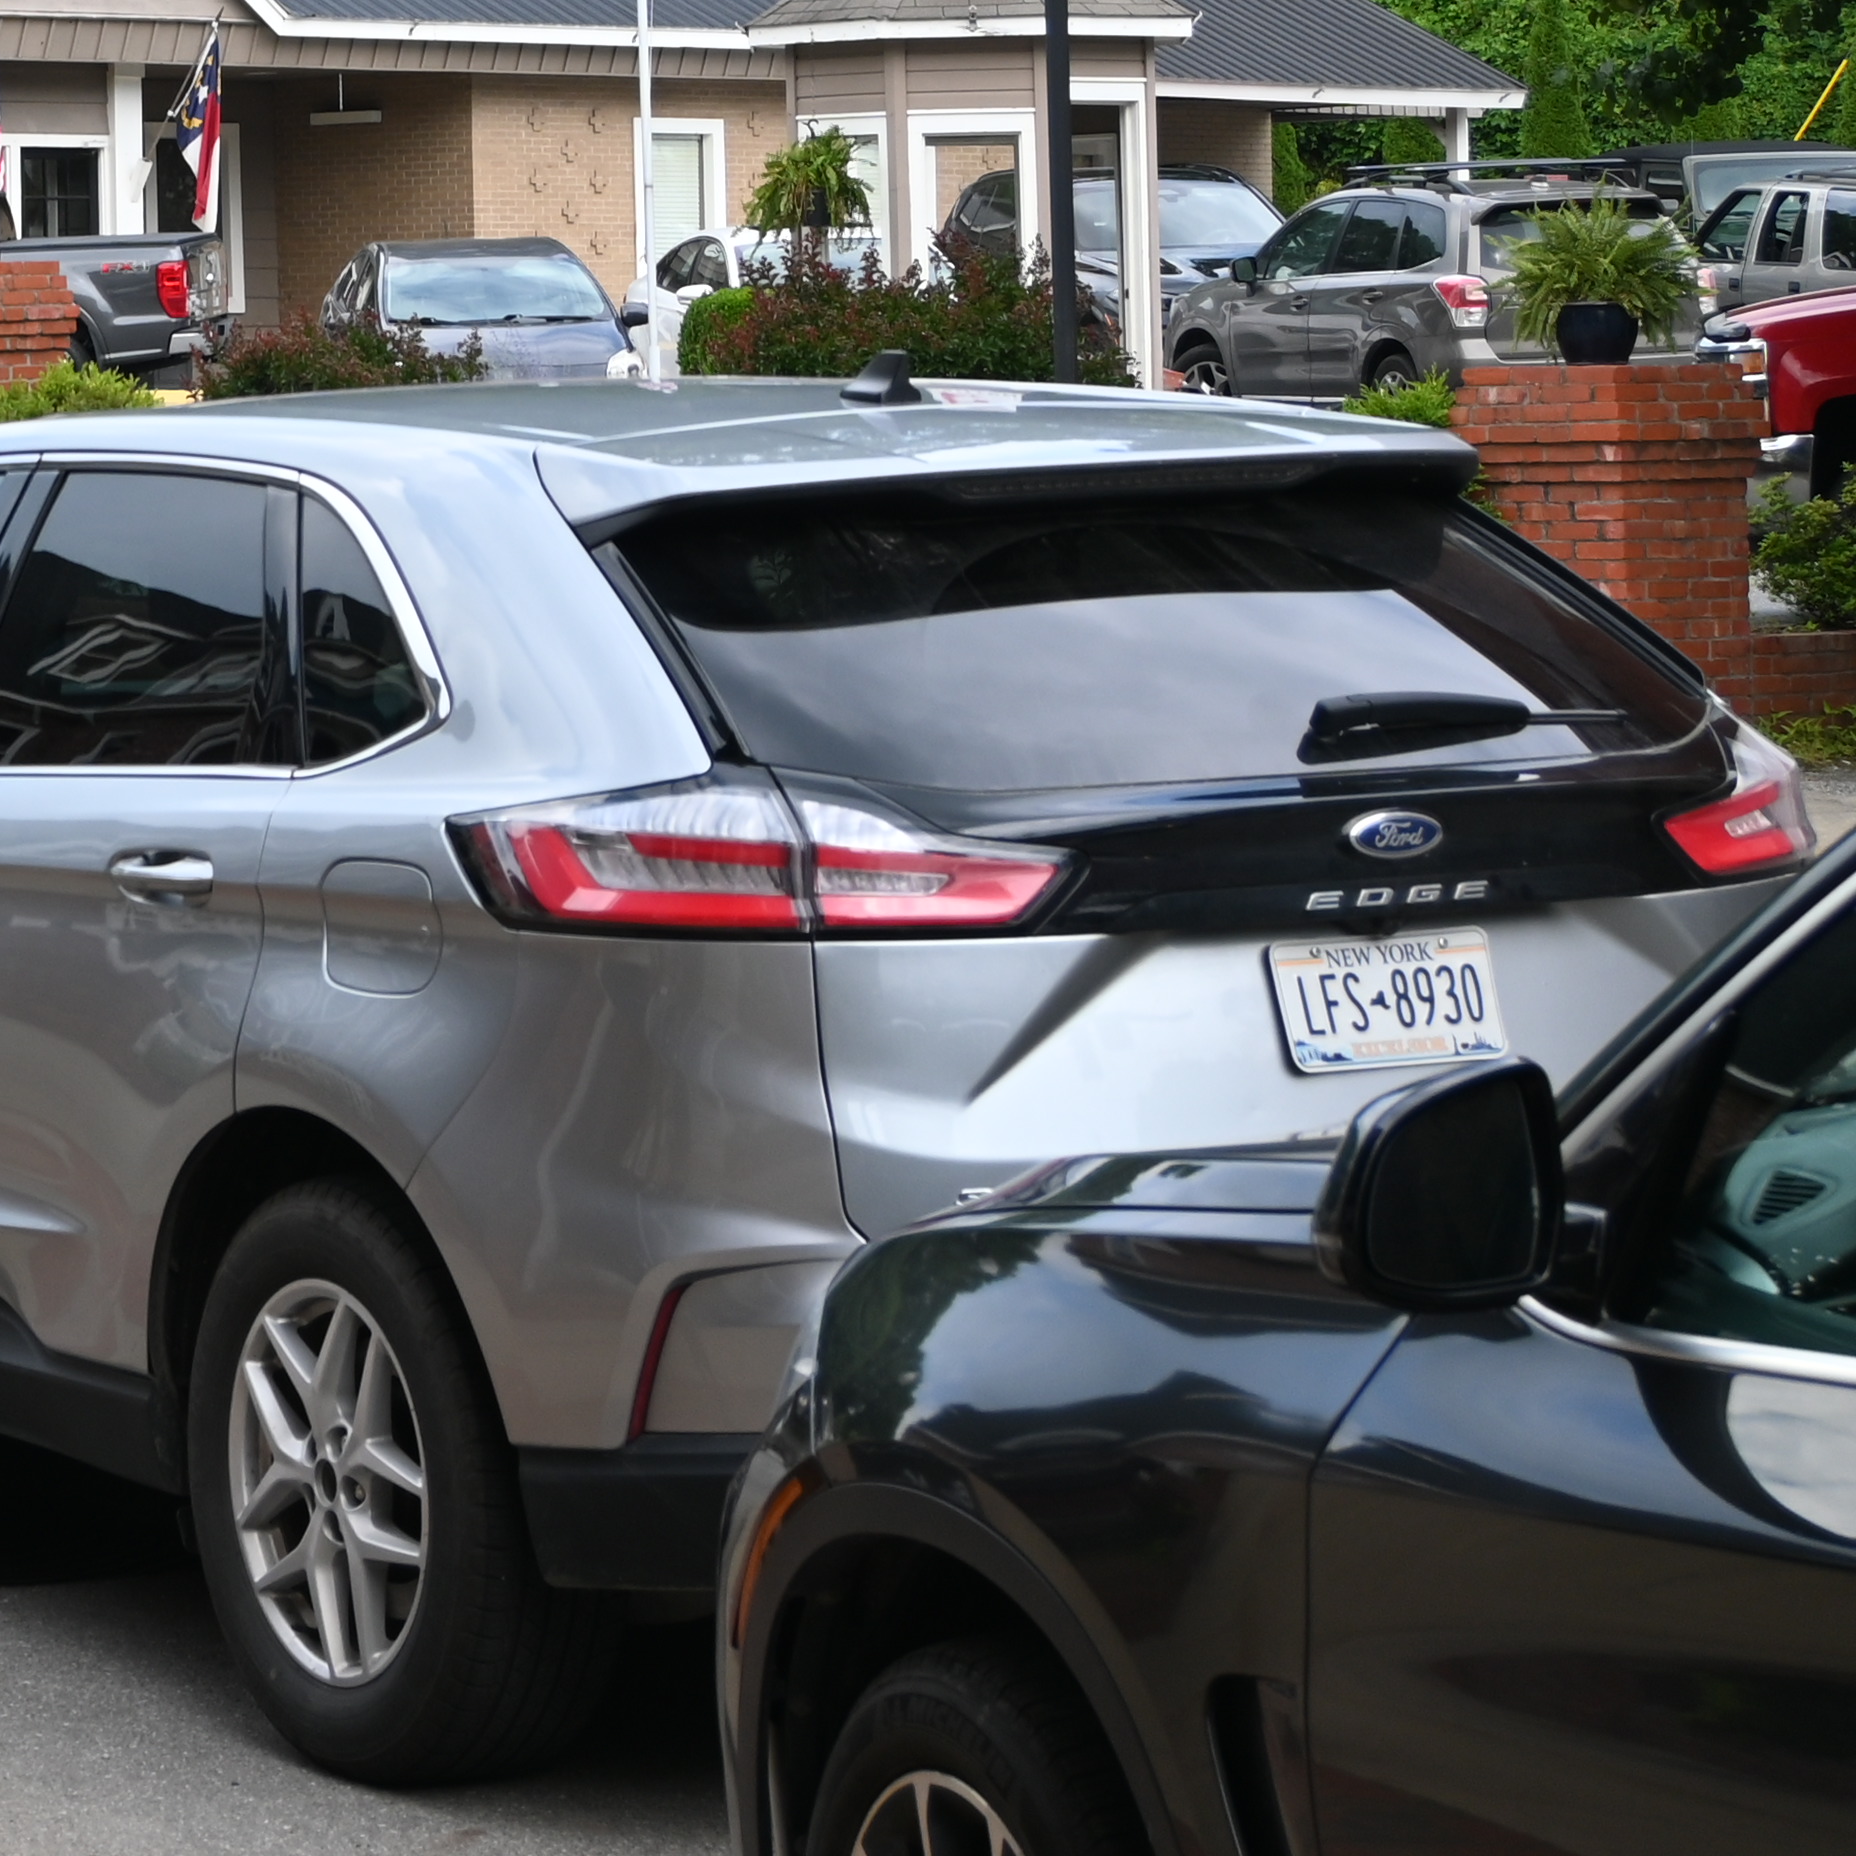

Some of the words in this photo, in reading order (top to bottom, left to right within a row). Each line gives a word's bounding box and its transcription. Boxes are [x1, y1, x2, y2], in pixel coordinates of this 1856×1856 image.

[1375, 821, 1425, 848] Ford
[1306, 880, 1489, 911] EDGE
[1325, 947, 1372, 969] NEW
[1375, 941, 1435, 965] YORK
